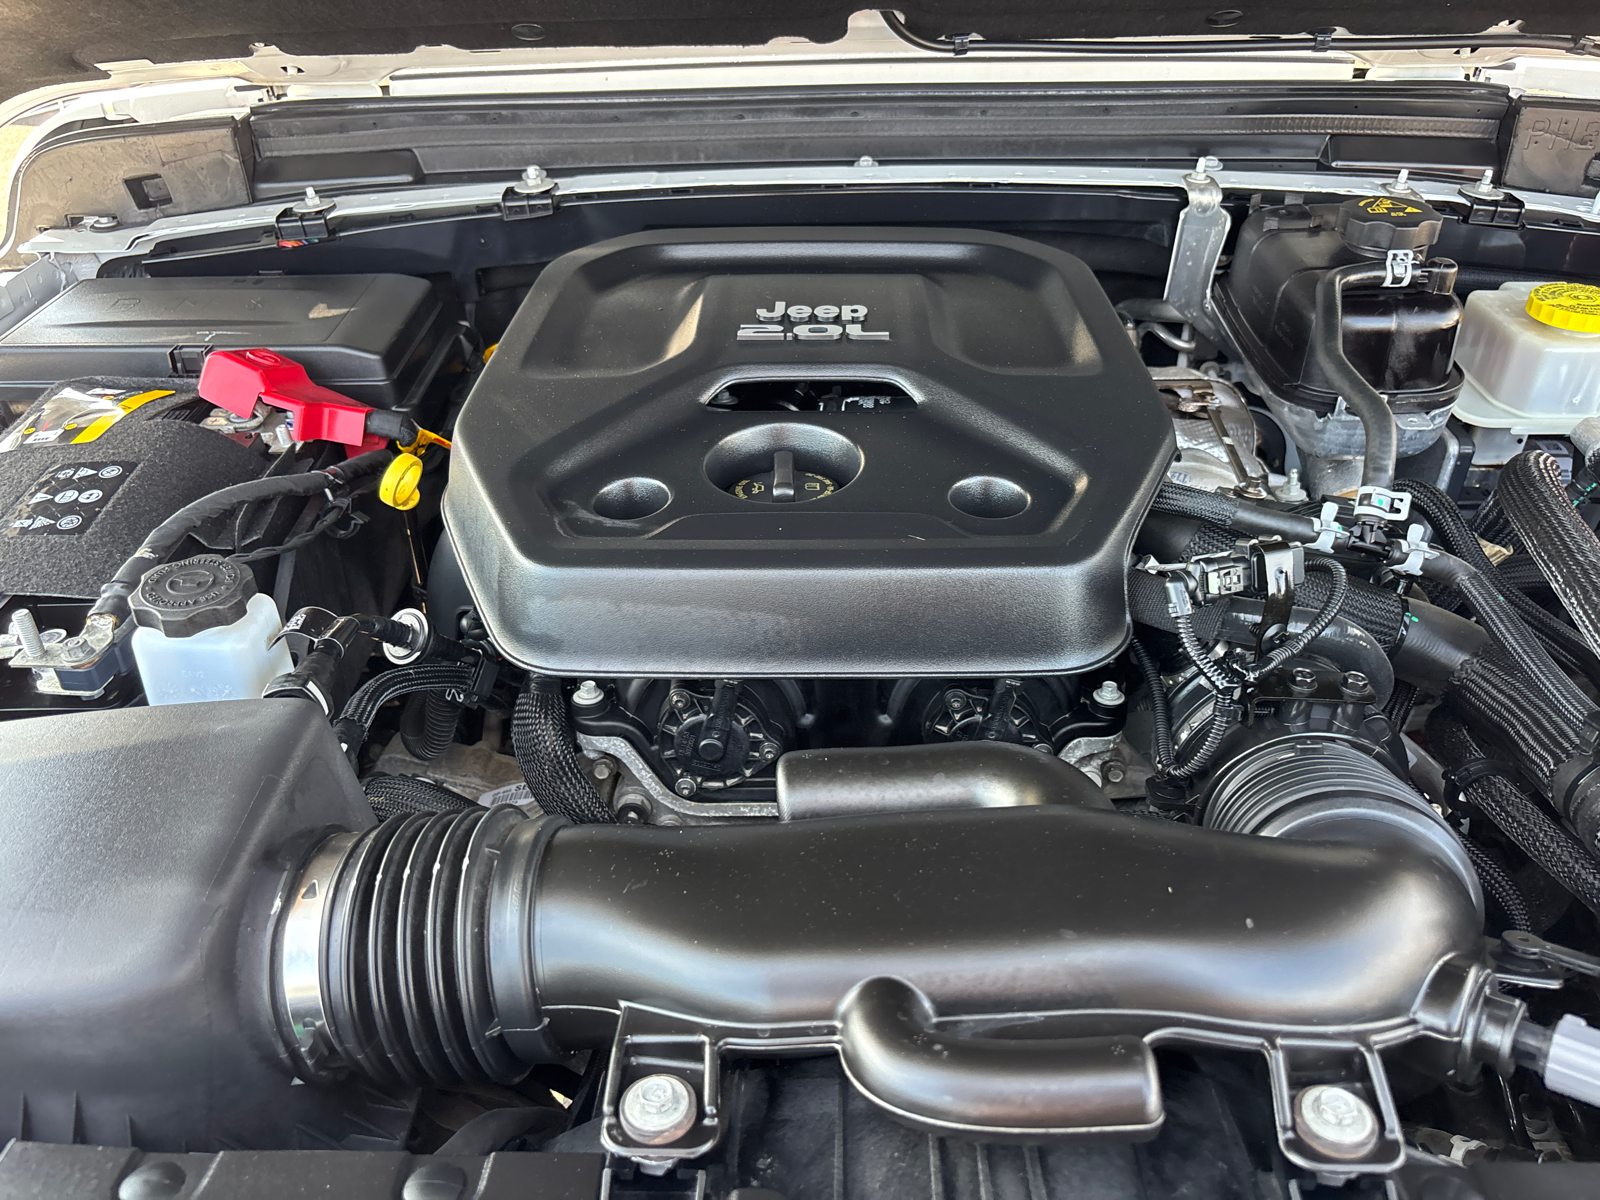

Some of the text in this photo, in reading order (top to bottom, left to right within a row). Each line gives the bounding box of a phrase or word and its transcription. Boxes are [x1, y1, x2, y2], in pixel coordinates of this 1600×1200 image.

[756, 301, 868, 322] Jeep
[737, 324, 890, 341] 2.0L
[171, 558, 222, 569] STEERING
[148, 566, 171, 583] FLUID
[146, 590, 220, 607] USE APPROVED
